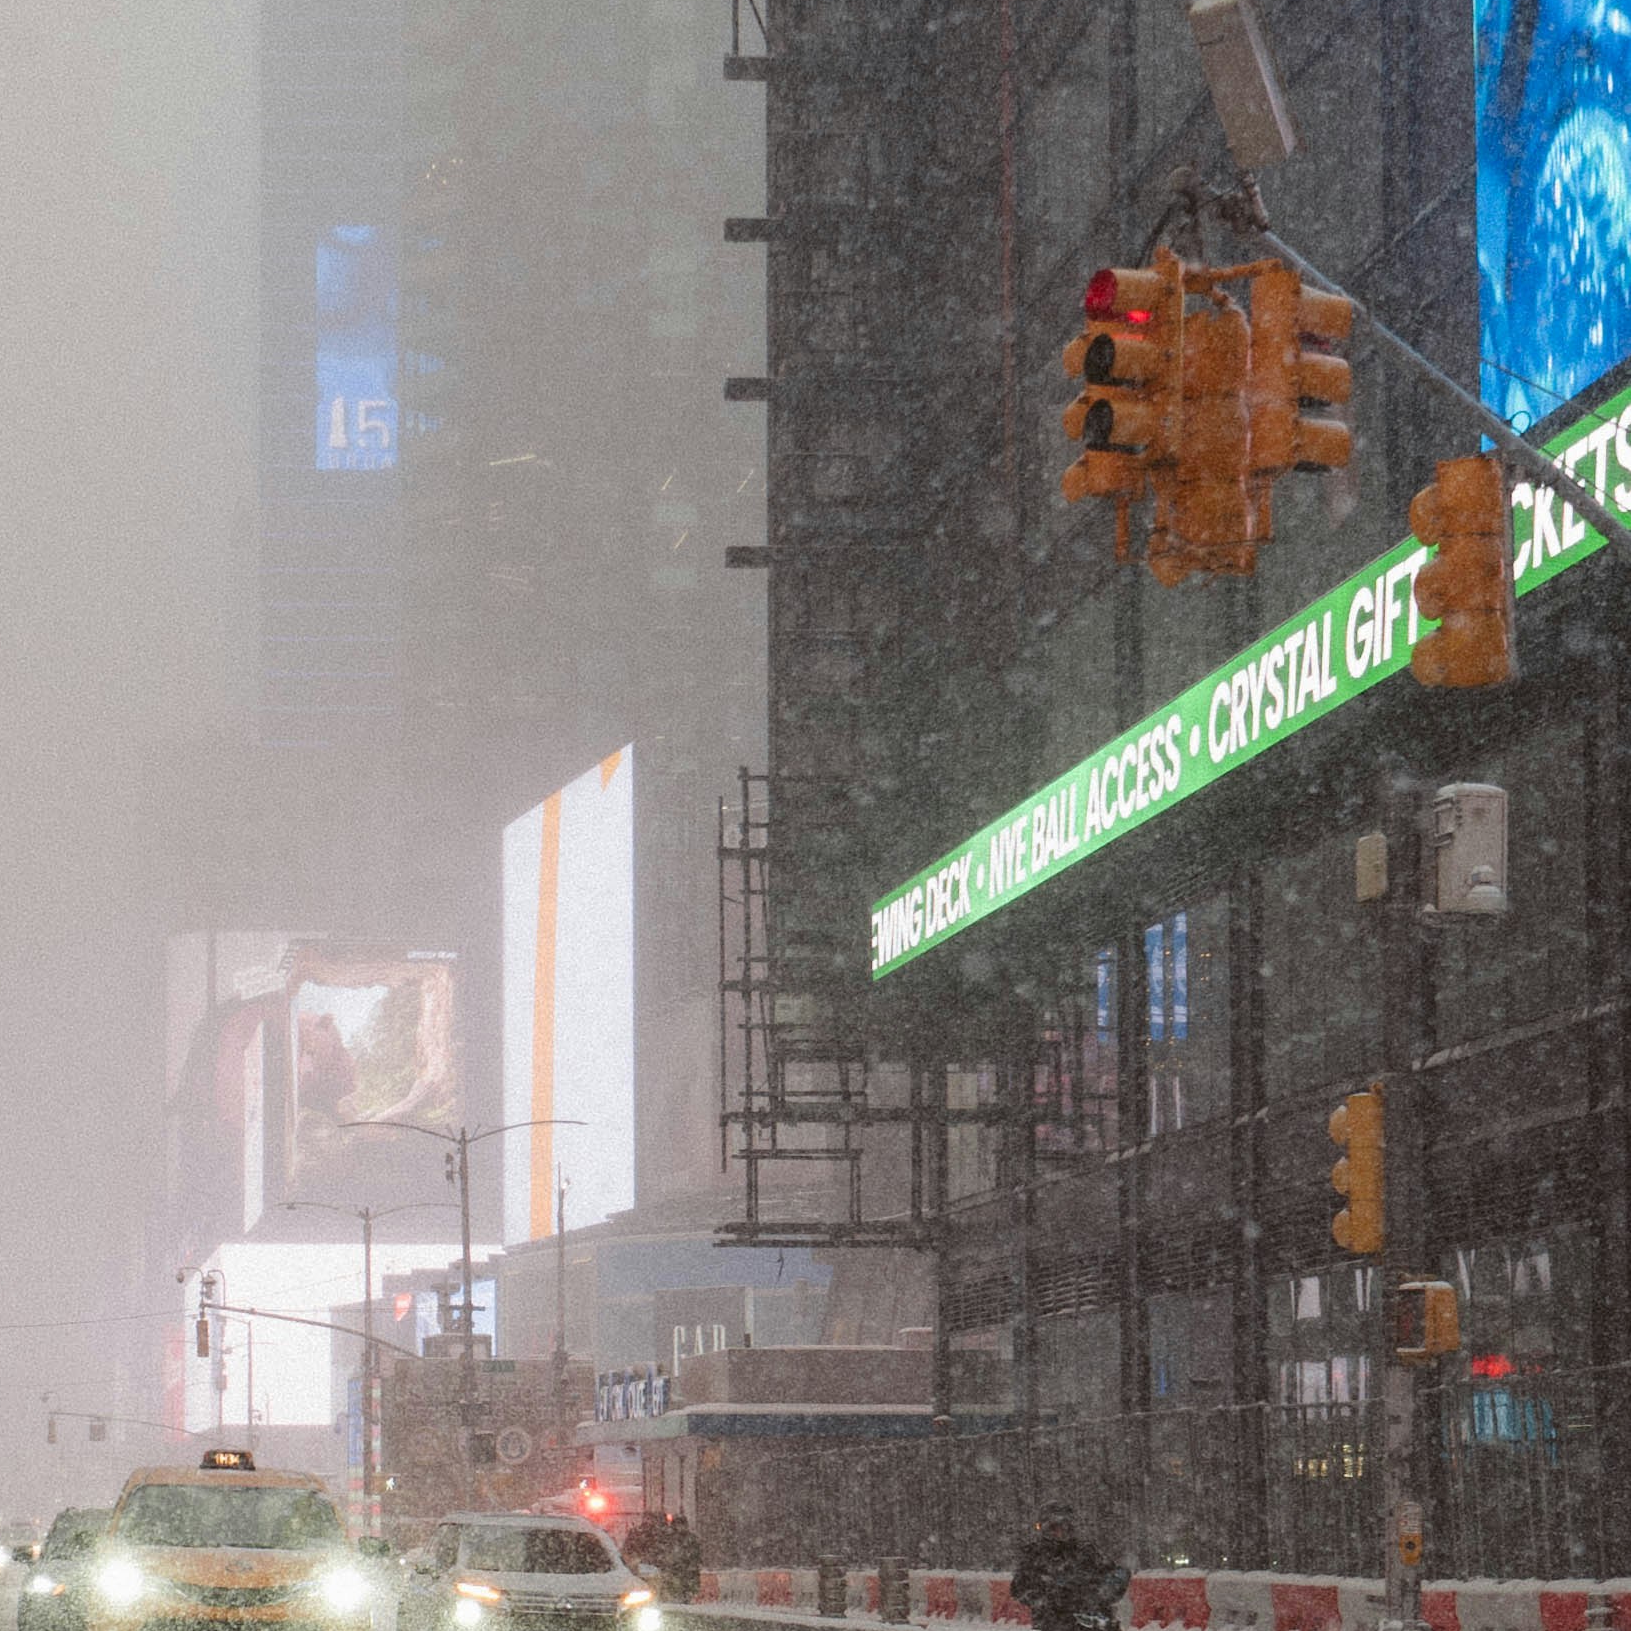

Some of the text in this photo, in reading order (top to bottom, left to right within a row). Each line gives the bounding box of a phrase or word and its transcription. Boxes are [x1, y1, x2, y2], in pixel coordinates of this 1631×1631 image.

[925, 851, 973, 939] DECK
[988, 815, 1029, 899] NYE
[1030, 782, 1080, 875] BALL
[1083, 714, 1183, 842] ACCESS
[1207, 611, 1339, 764] CRYSTAL
